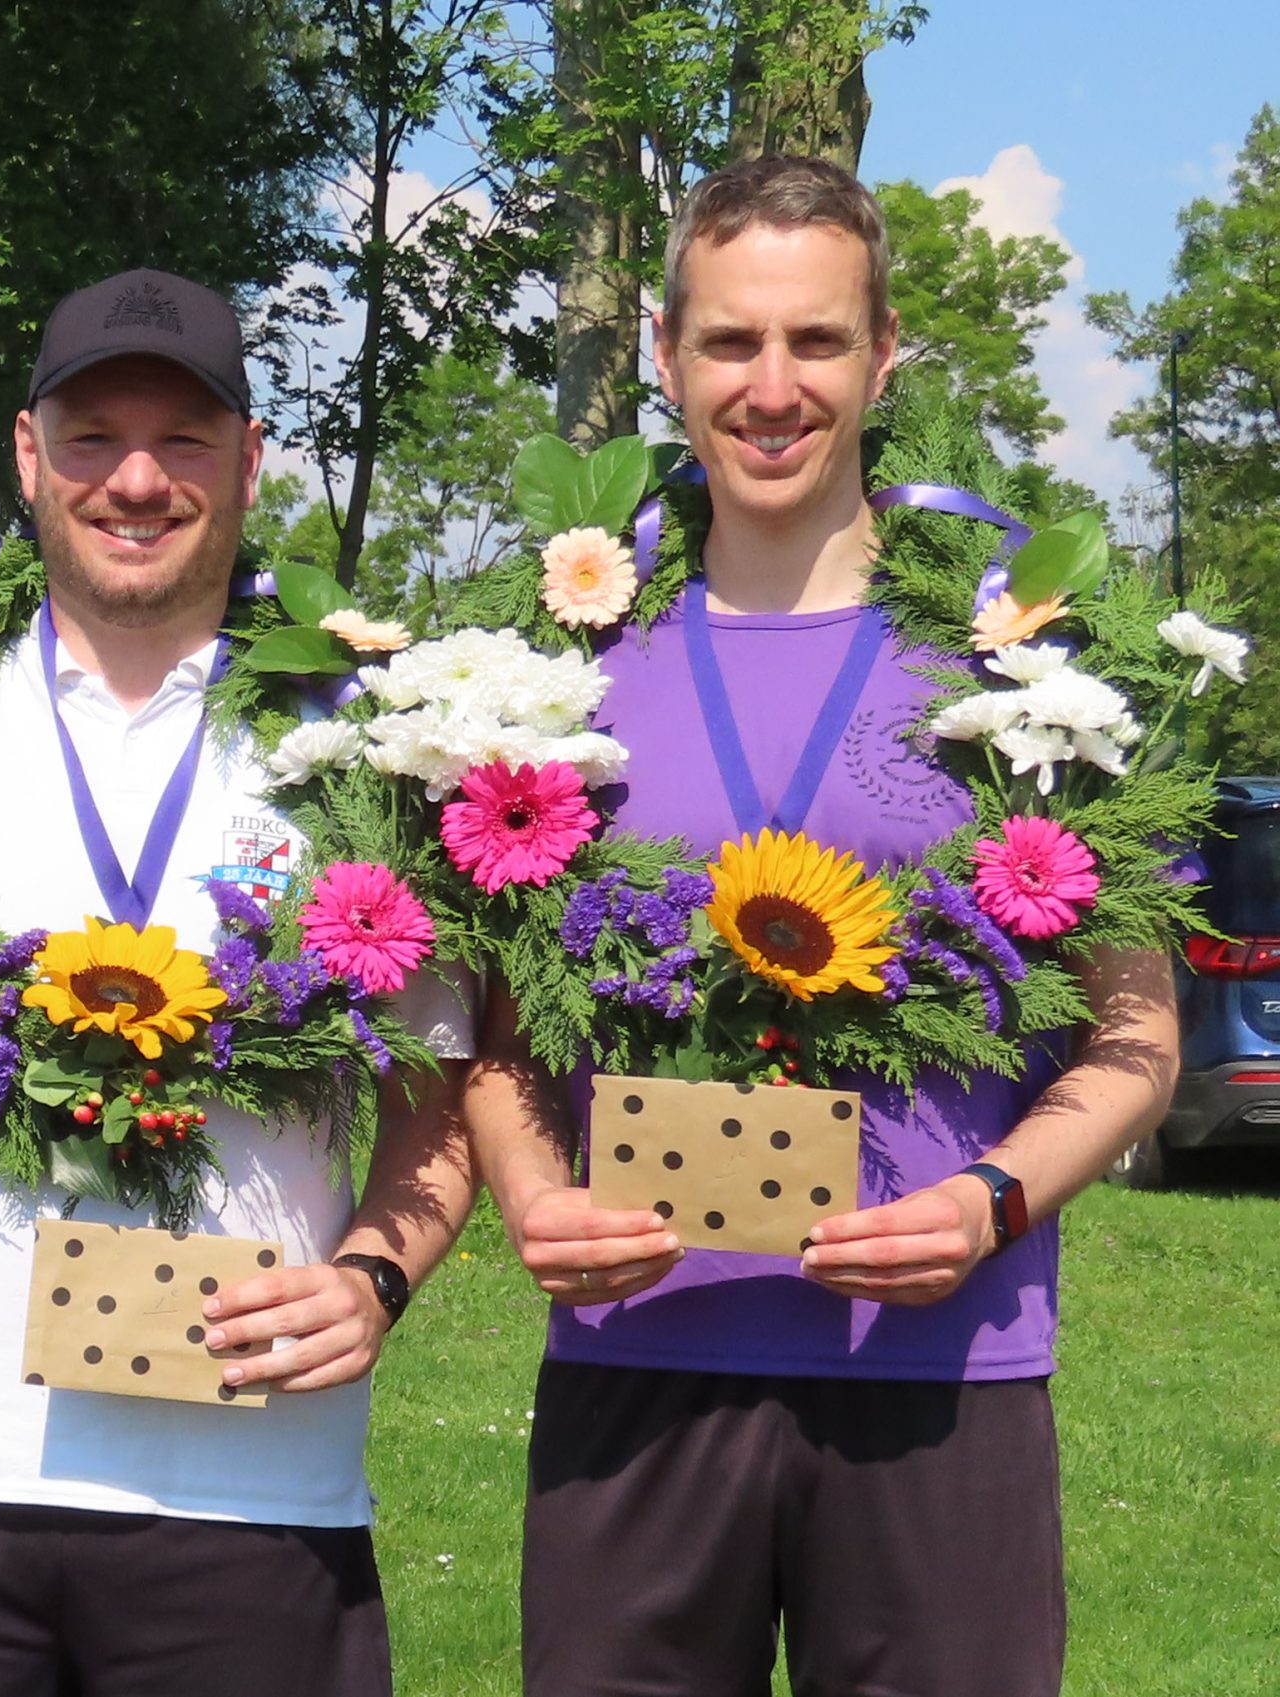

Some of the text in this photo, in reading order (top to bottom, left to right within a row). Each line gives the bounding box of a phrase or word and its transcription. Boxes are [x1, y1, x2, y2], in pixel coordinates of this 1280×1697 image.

[231, 815, 287, 834] HDKC
[222, 868, 286, 887] 25 JAAR
